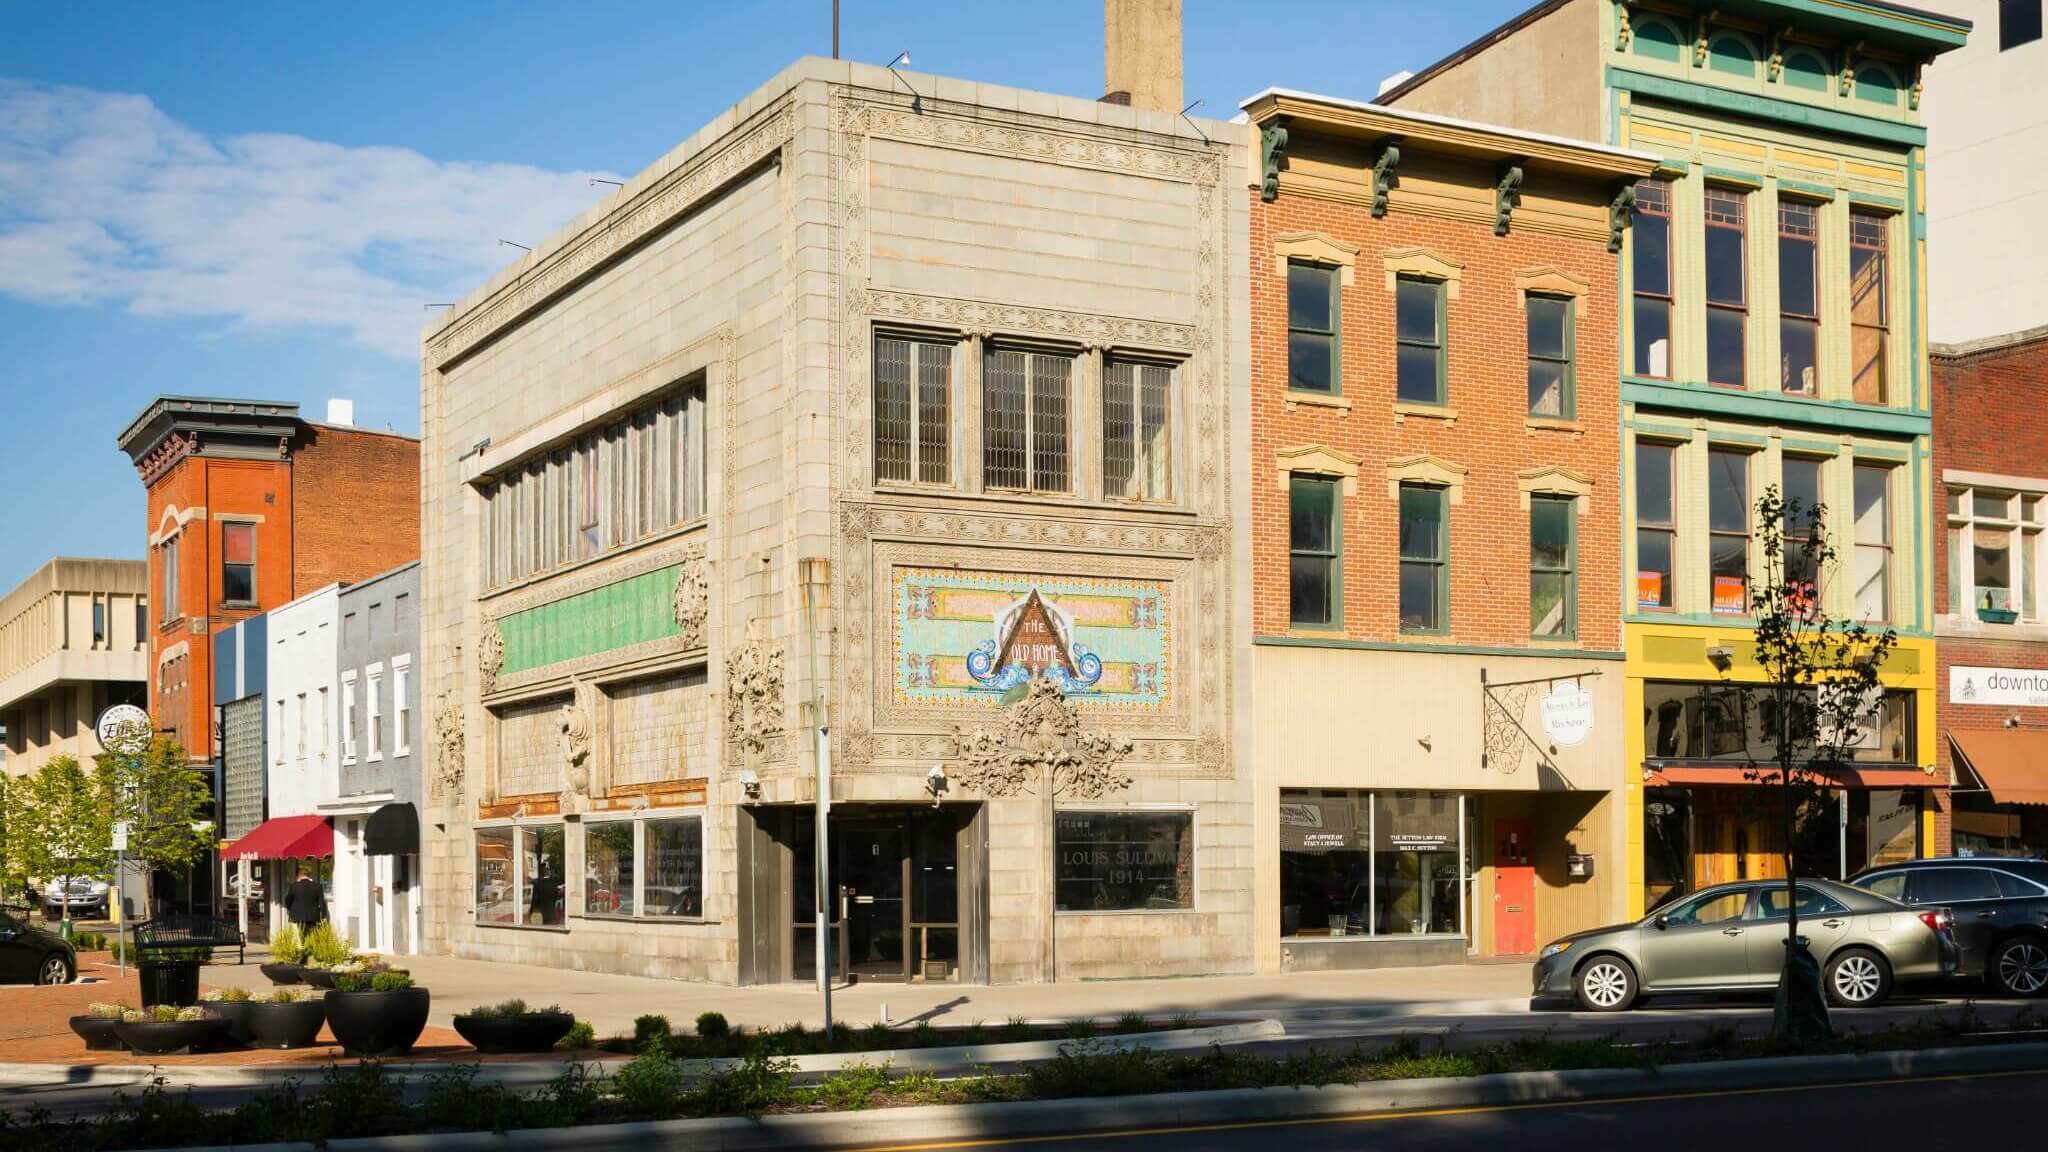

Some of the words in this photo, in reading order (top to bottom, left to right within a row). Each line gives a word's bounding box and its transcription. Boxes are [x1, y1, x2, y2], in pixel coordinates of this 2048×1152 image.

[1024, 619, 1047, 633] THE
[1011, 644, 1030, 661] OLD
[1032, 644, 1064, 662] HOME
[1063, 850, 1110, 865] LOUIS
[1116, 850, 1178, 866] SULLIVA
[1109, 869, 1145, 884] 1914
